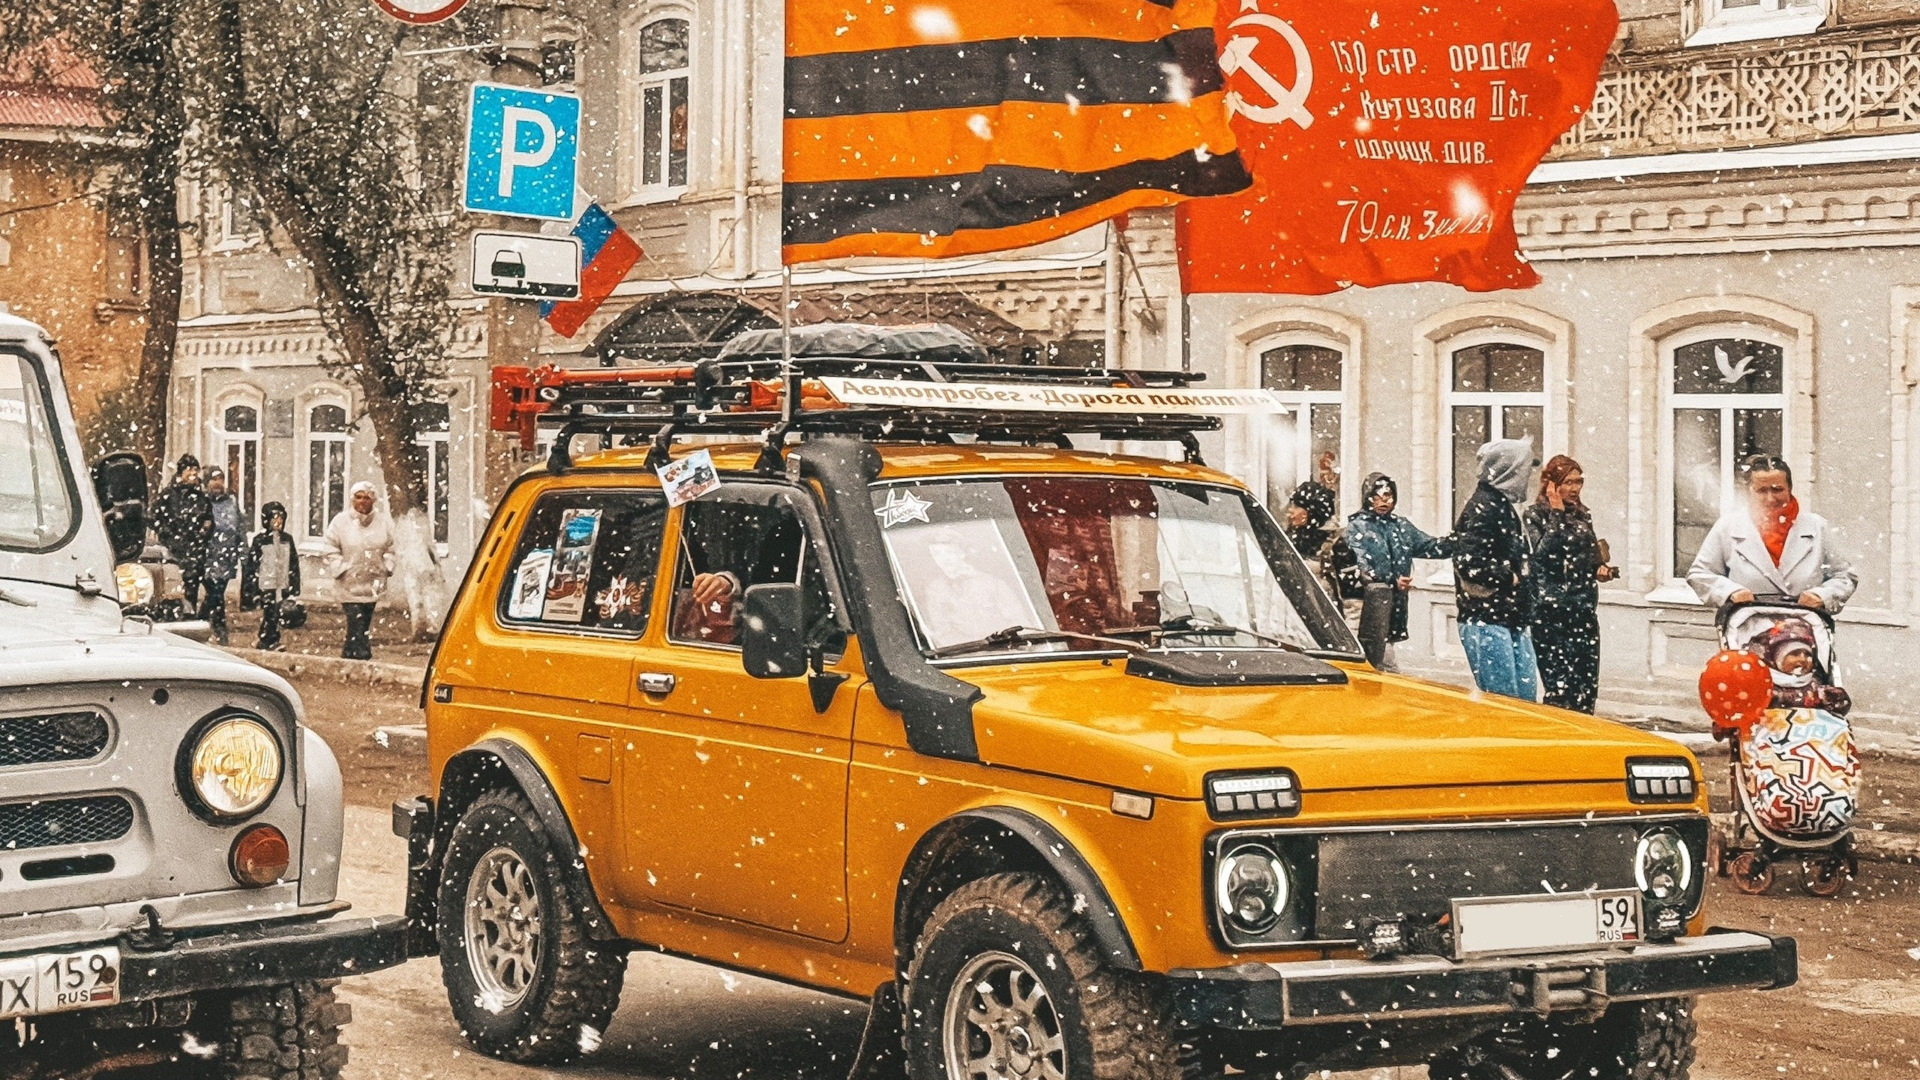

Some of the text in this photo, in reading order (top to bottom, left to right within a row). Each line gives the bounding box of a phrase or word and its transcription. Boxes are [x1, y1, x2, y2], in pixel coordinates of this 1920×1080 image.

[1448, 42, 1532, 72] ОРДЕНА
[498, 105, 557, 198] P
[842, 380, 1024, 403] Автопробег
[1029, 389, 1145, 408] «Дорога
[1601, 898, 1629, 928] 59
[1600, 929, 1622, 941] RUS
[43, 954, 107, 993] 159
[57, 989, 89, 1006] RUS
